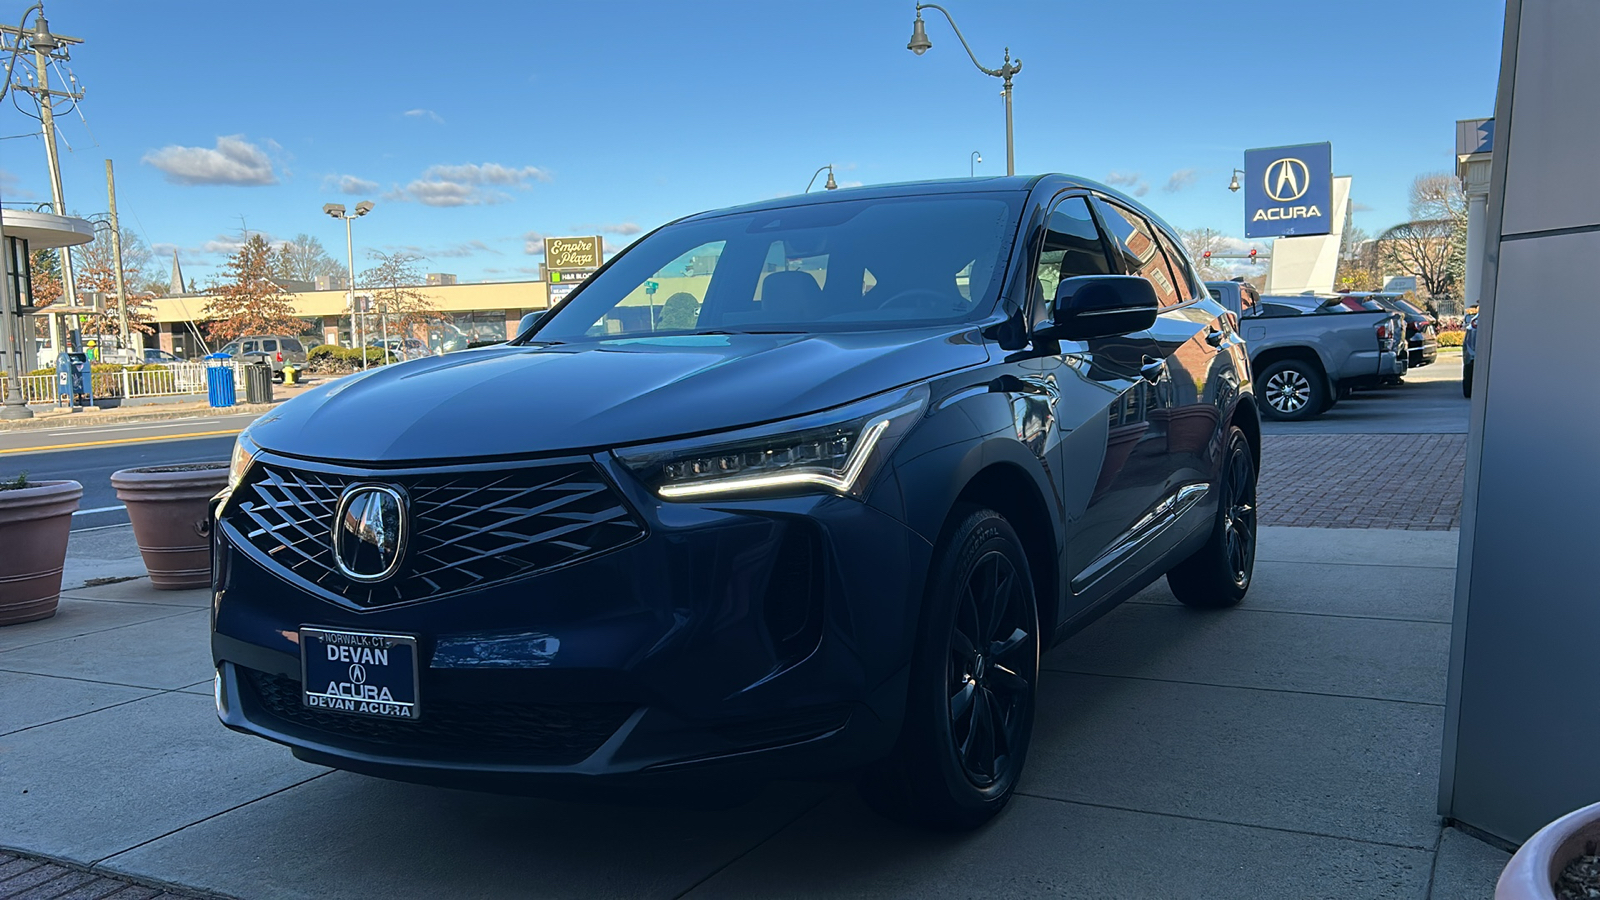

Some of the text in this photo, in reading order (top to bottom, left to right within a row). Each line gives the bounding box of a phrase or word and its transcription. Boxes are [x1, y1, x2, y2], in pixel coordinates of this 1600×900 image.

[1253, 205, 1321, 221] ACURA
[550, 239, 592, 255] Empire
[556, 251, 593, 266] Plaza
[371, 636, 384, 647] CT
[326, 644, 388, 666] DEVAN
[326, 681, 394, 702] ACURA
[309, 695, 411, 717] DEVAN ACURA
